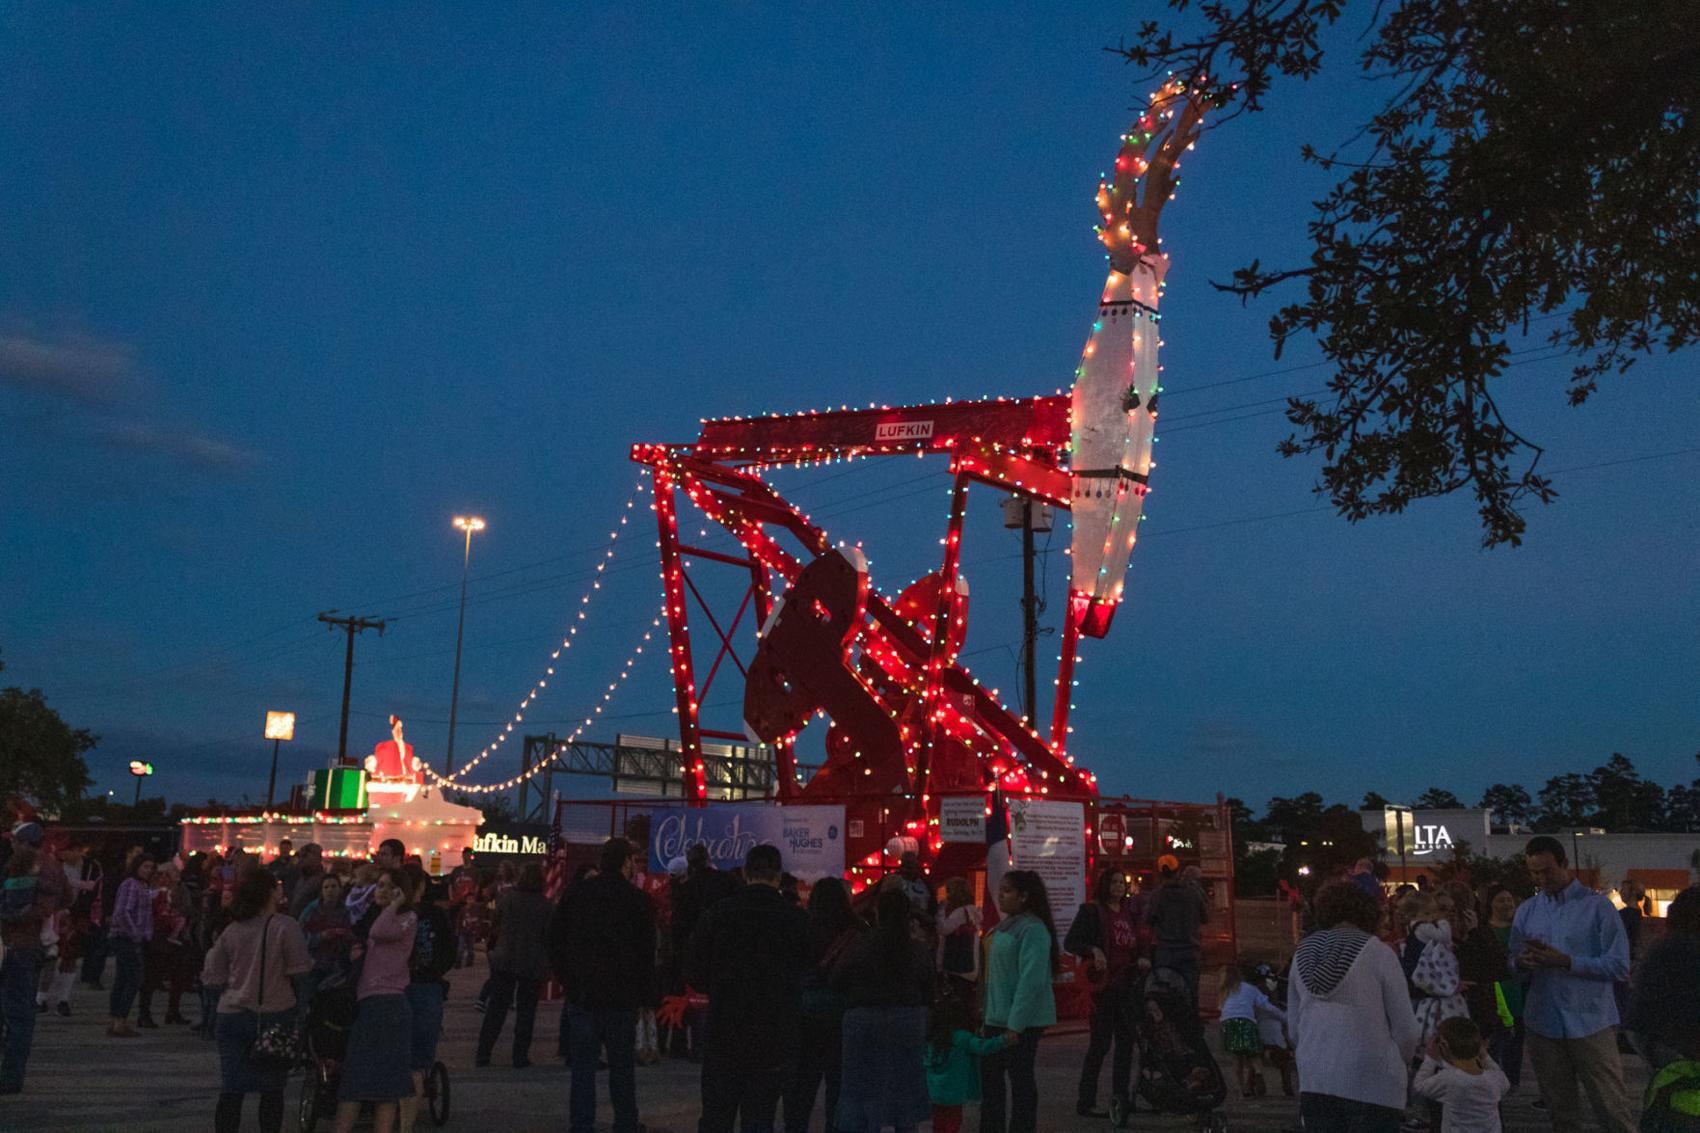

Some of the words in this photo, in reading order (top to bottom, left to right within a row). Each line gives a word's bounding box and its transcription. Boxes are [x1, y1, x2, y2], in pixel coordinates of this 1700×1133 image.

[879, 424, 930, 437] LUFKIN
[783, 827, 809, 838] BAKER
[1414, 825, 1452, 845] LTA
[473, 833, 519, 853] ufkin
[789, 838, 823, 851] HUGHES
